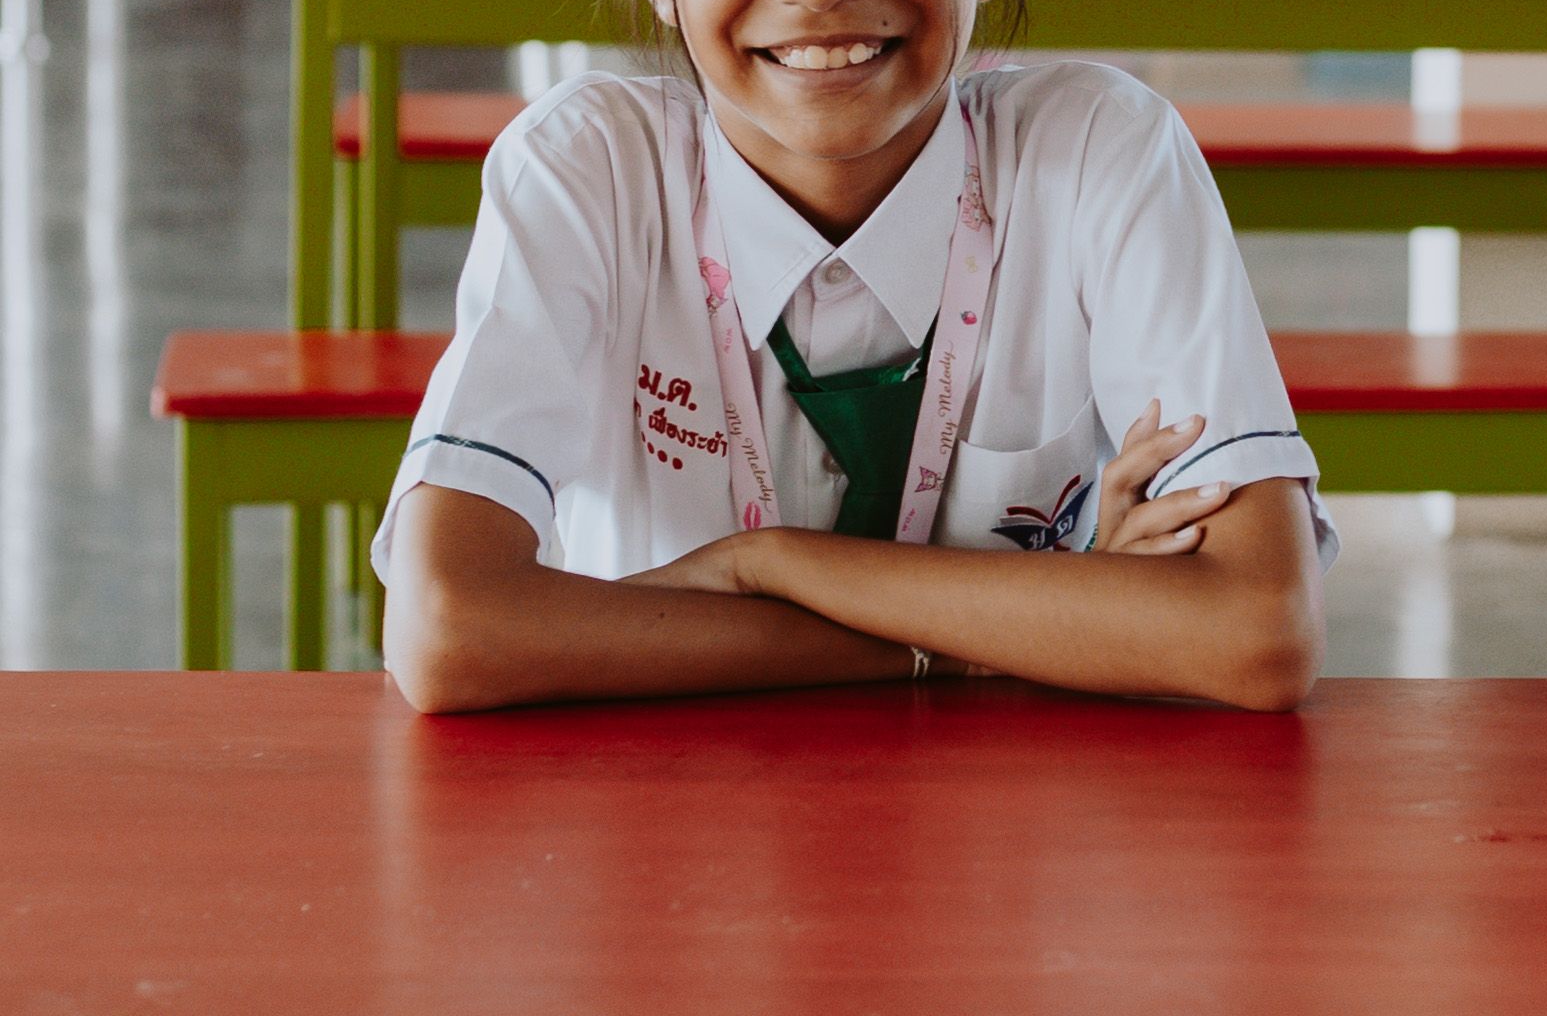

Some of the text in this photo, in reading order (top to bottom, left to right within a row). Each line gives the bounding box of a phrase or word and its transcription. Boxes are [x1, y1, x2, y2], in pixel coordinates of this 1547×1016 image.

[937, 340, 958, 455] My Melody
[726, 402, 774, 513] My Melody
